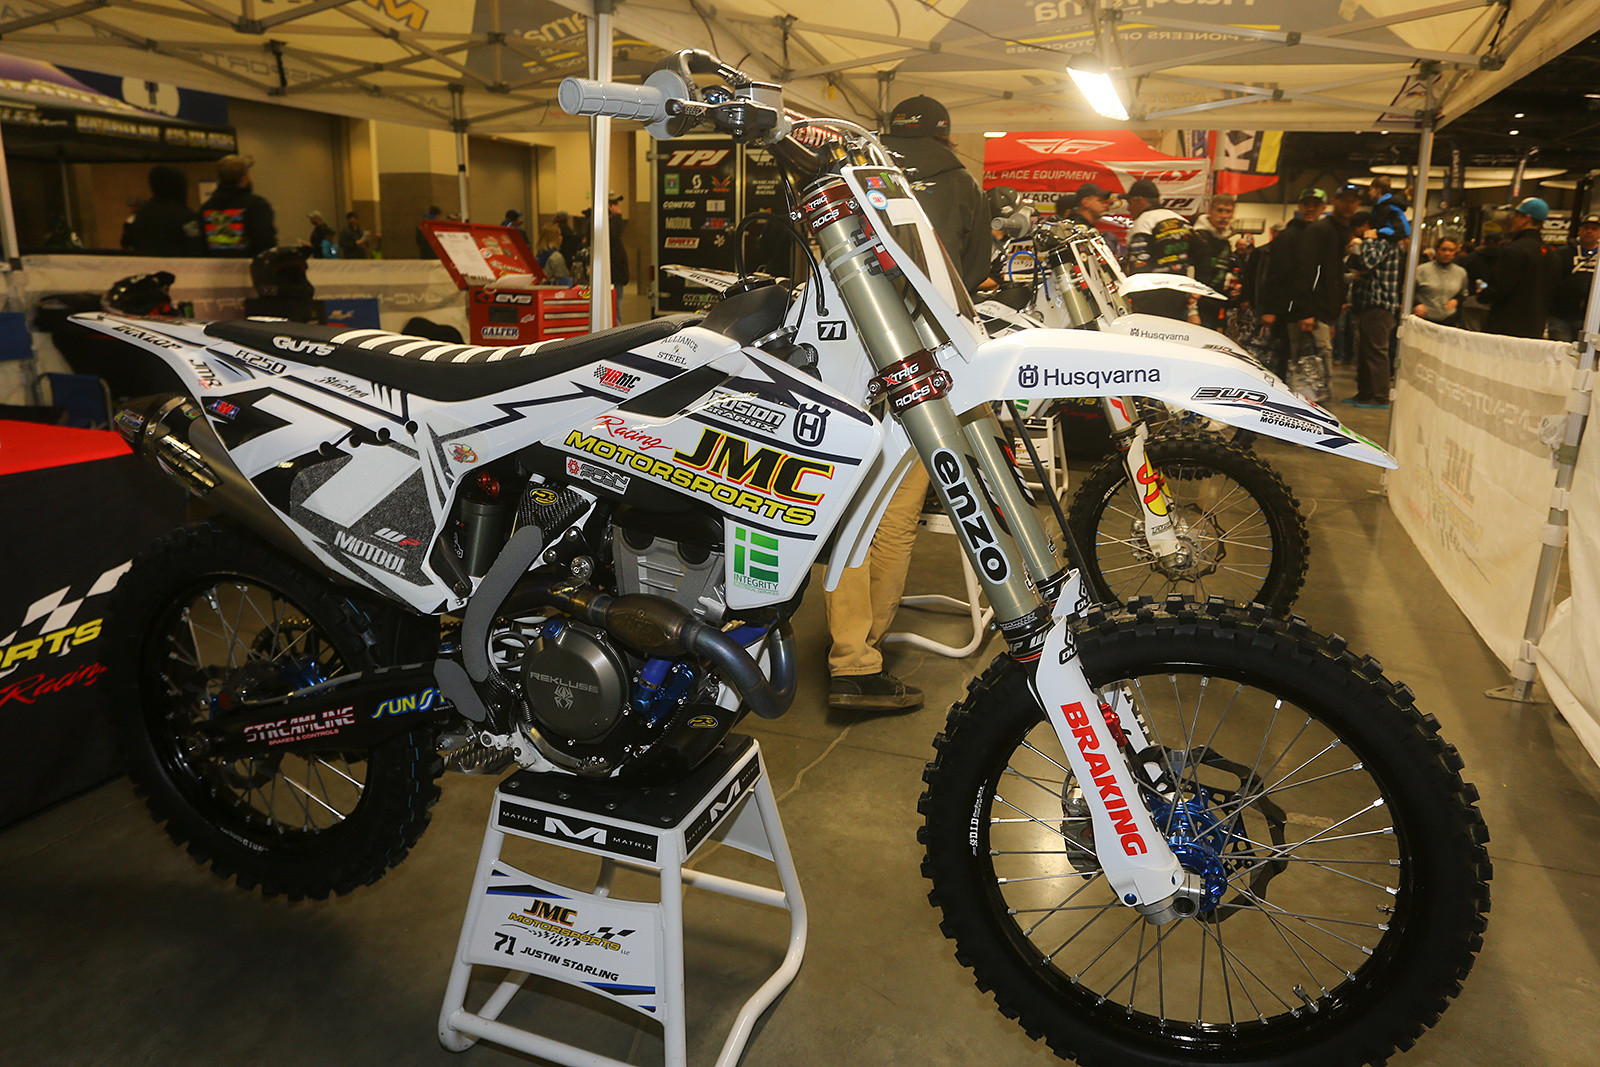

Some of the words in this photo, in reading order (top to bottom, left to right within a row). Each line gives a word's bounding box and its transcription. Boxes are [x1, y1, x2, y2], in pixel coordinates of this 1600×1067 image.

[666, 149, 732, 168] TPJ
[1001, 170, 1030, 180] RACE
[1033, 170, 1099, 181] EQUIPMENT
[803, 195, 828, 213] XTRIG
[812, 208, 840, 229] ROCS
[481, 327, 519, 338] GALFER
[820, 323, 844, 338] 71
[1140, 331, 1189, 342] Husqvarna
[272, 336, 337, 357] GUTS
[660, 335, 699, 353] ALLIANCE
[234, 349, 288, 376] FC250
[656, 352, 688, 366] STEEL
[883, 363, 920, 386] XTRIG
[1043, 367, 1161, 389] Husqvarna
[895, 384, 931, 408] ROCS
[594, 415, 673, 451] Racing
[563, 429, 817, 526] MOTORSPORTS
[672, 427, 835, 506] JMC
[932, 448, 1011, 585] enzo
[733, 573, 779, 591] INTEGRITY
[529, 670, 599, 695] REKLUSE
[243, 706, 355, 743] STREAMLINE
[301, 728, 339, 740] CONTROLS
[1060, 701, 1148, 858] BRAKING
[502, 810, 539, 825] MATRIX
[612, 836, 653, 850] MATRIX
[523, 898, 579, 928] JMC
[508, 912, 621, 952] MOTORSPORTS
[493, 931, 515, 956] 71
[520, 946, 559, 965] JUSTIN
[561, 957, 619, 982] STARLING
